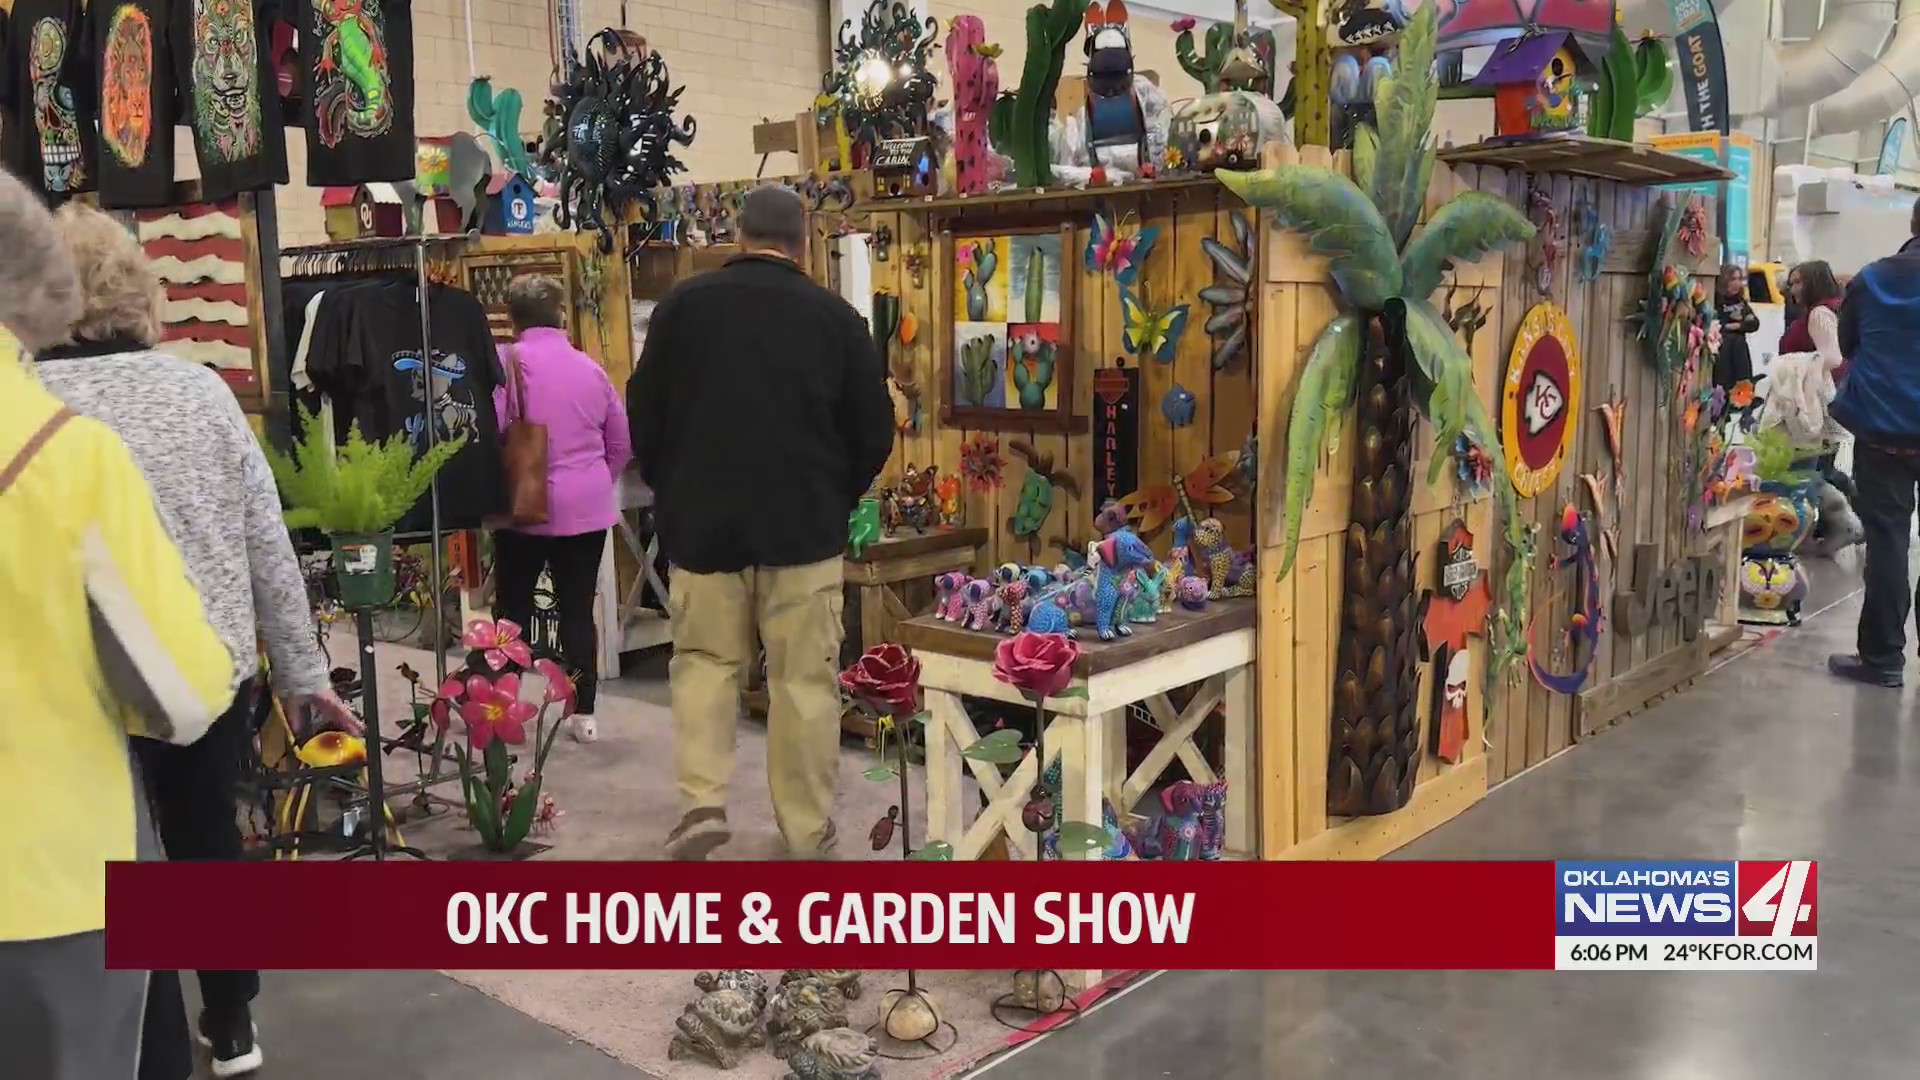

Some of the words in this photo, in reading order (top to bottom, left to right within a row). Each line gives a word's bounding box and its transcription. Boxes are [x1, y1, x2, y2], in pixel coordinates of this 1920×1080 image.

[1688, 35, 1707, 77] GOAT
[1697, 79, 1711, 110] THE
[1105, 404, 1117, 497] HARLEY
[1612, 543, 1720, 642] Jeep
